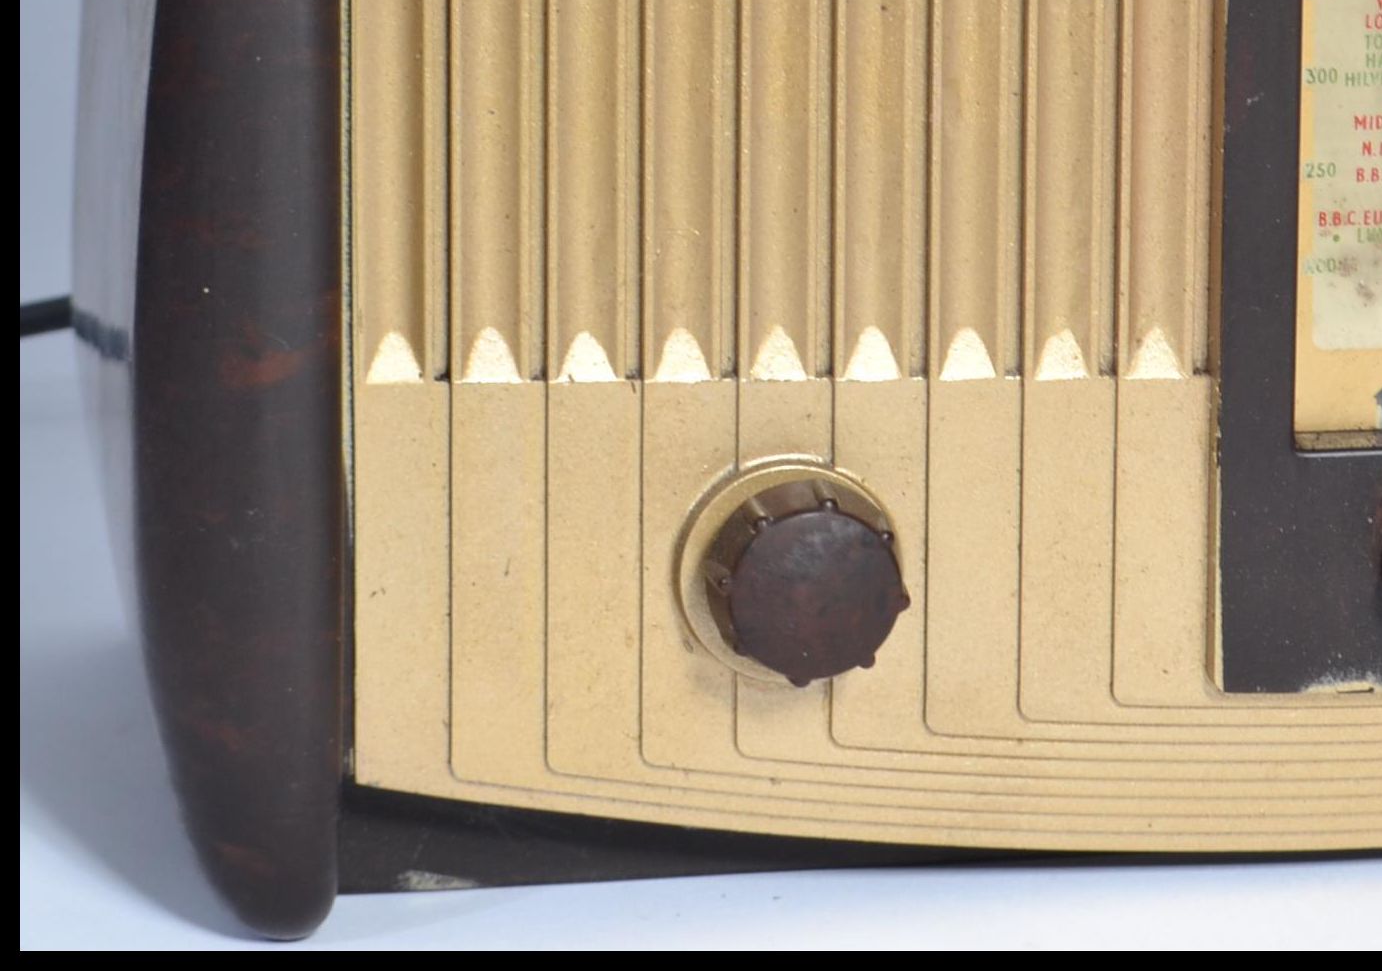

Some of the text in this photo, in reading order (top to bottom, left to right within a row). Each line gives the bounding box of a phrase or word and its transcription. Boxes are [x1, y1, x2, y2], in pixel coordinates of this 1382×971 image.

[1306, 68, 1338, 85] 300
[1306, 162, 1336, 179] 250
[1306, 257, 1336, 274] 00
